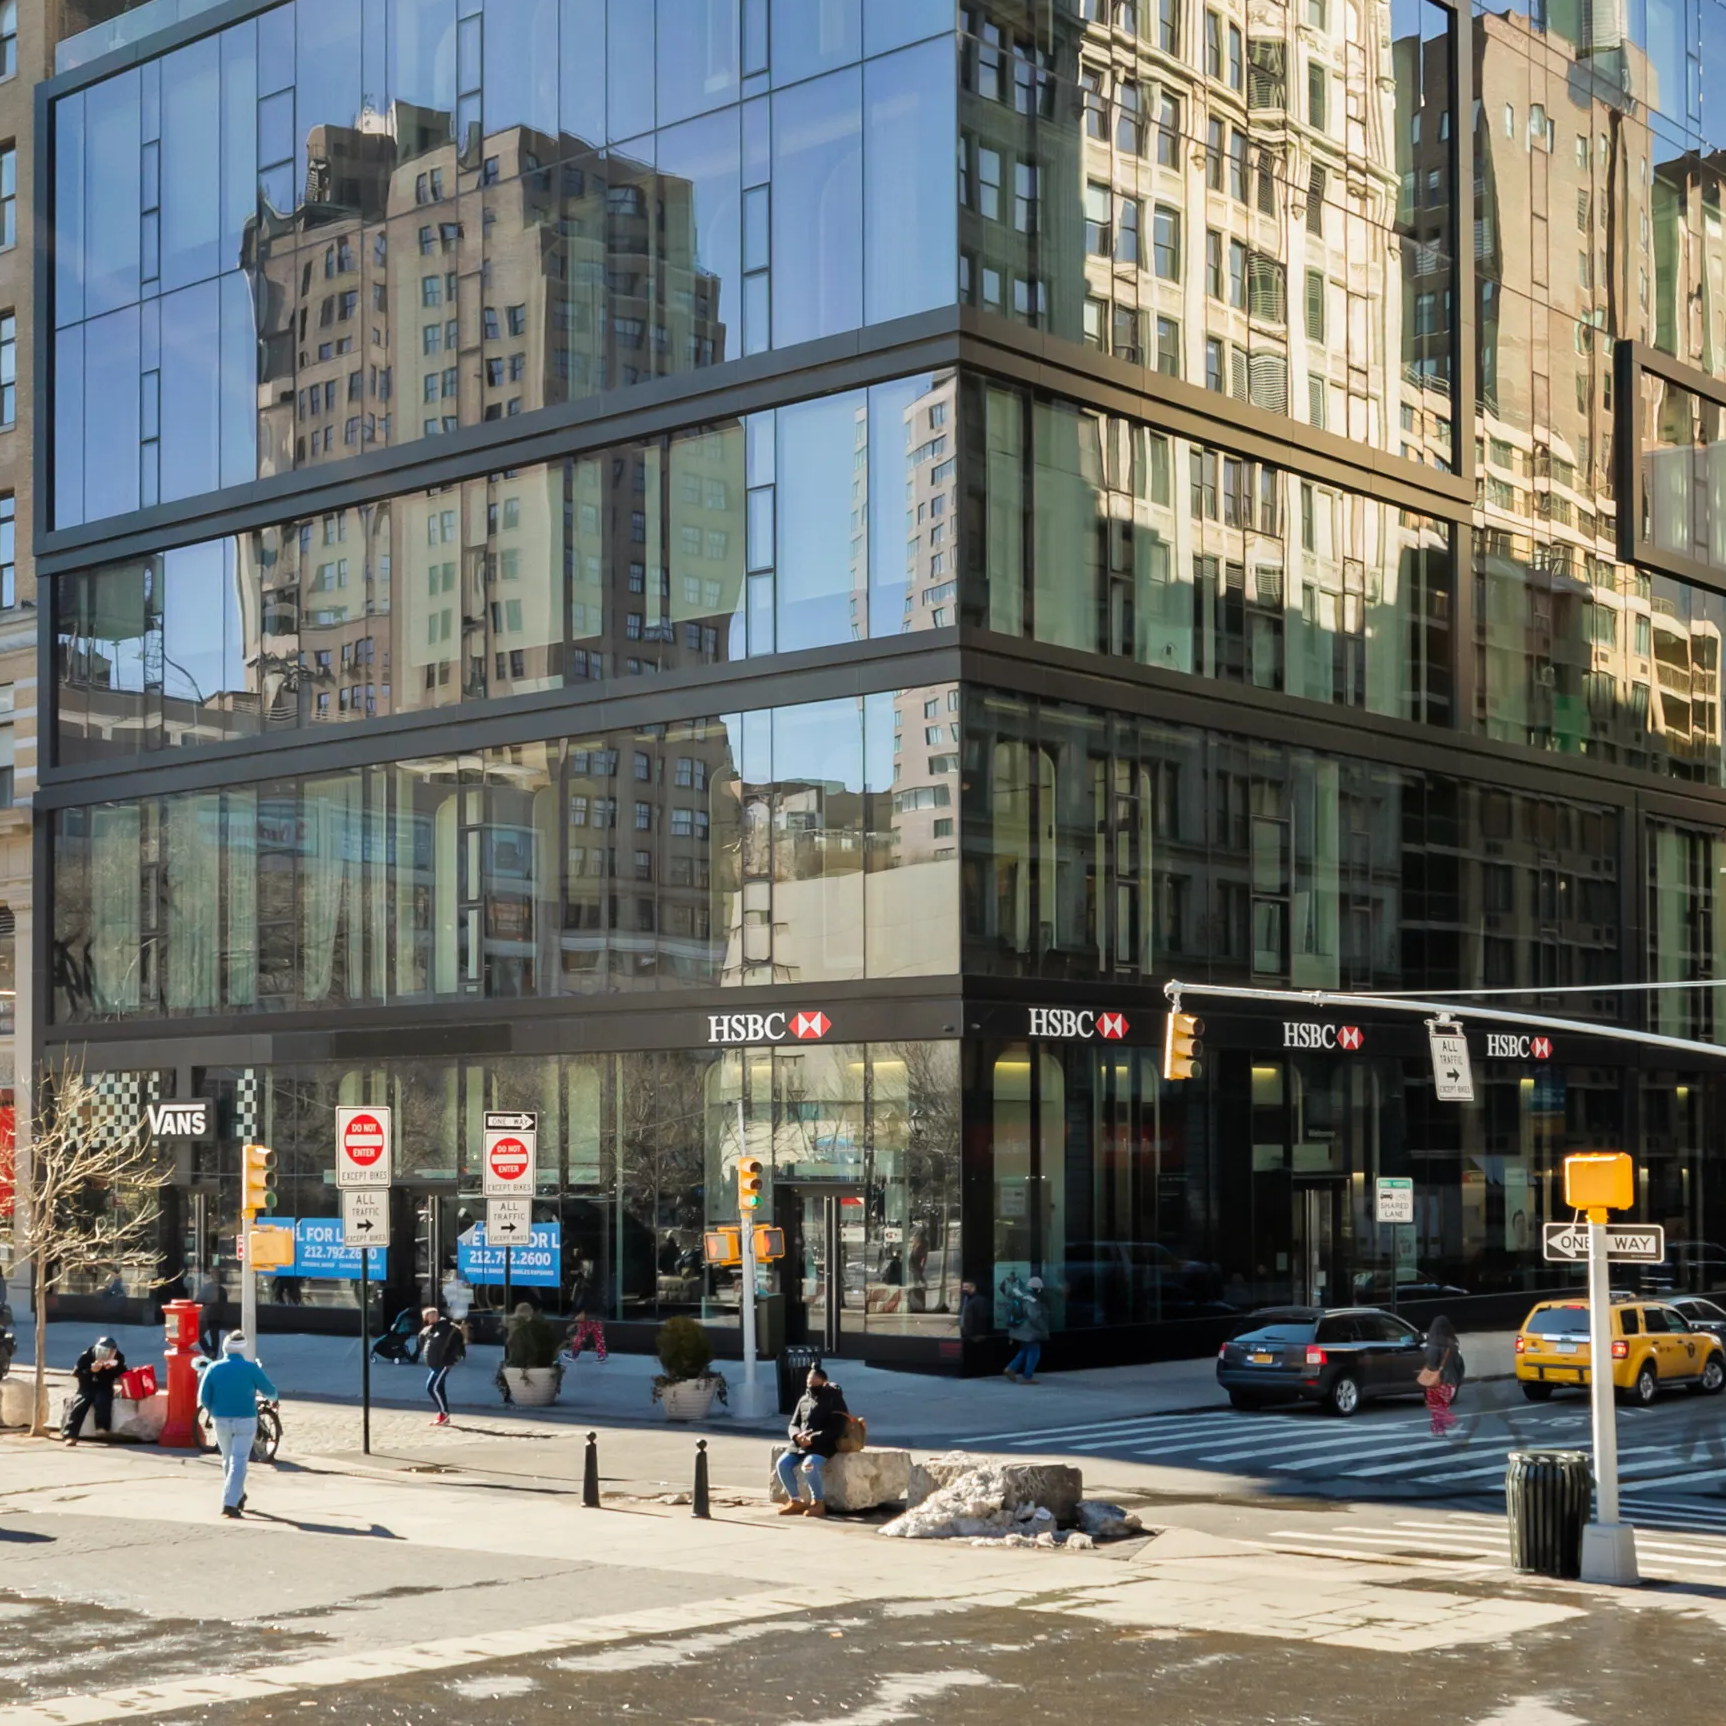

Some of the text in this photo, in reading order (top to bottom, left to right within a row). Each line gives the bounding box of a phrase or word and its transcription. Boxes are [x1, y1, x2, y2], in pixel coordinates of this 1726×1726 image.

[707, 1012, 786, 1042] HSBC
[1028, 1007, 1094, 1038] HSBC
[1282, 1022, 1336, 1049] HSBC
[1442, 1040, 1458, 1052] ALL
[1486, 1034, 1530, 1058] HSBC
[1439, 1054, 1464, 1065] TRAFFIC
[146, 1103, 206, 1135] VANS
[492, 1117, 529, 1126] ONE WAY
[351, 1123, 377, 1133] DO NOT
[352, 1147, 376, 1158] ENTER
[496, 1144, 522, 1153] DO NOT
[498, 1165, 520, 1174] ENTER
[341, 1170, 388, 1181] EXCEPT BIKES
[513, 1183, 531, 1191] BIKES
[356, 1194, 375, 1205] ALL
[352, 1207, 380, 1216] TRAFFIC
[500, 1202, 519, 1211] ALL
[1380, 1202, 1410, 1210] SHARED
[494, 1213, 526, 1221] TRAFFIC
[307, 1226, 333, 1242] FOR
[1561, 1236, 1651, 1251] ONE WAY
[304, 1245, 378, 1261] 212.792.260
